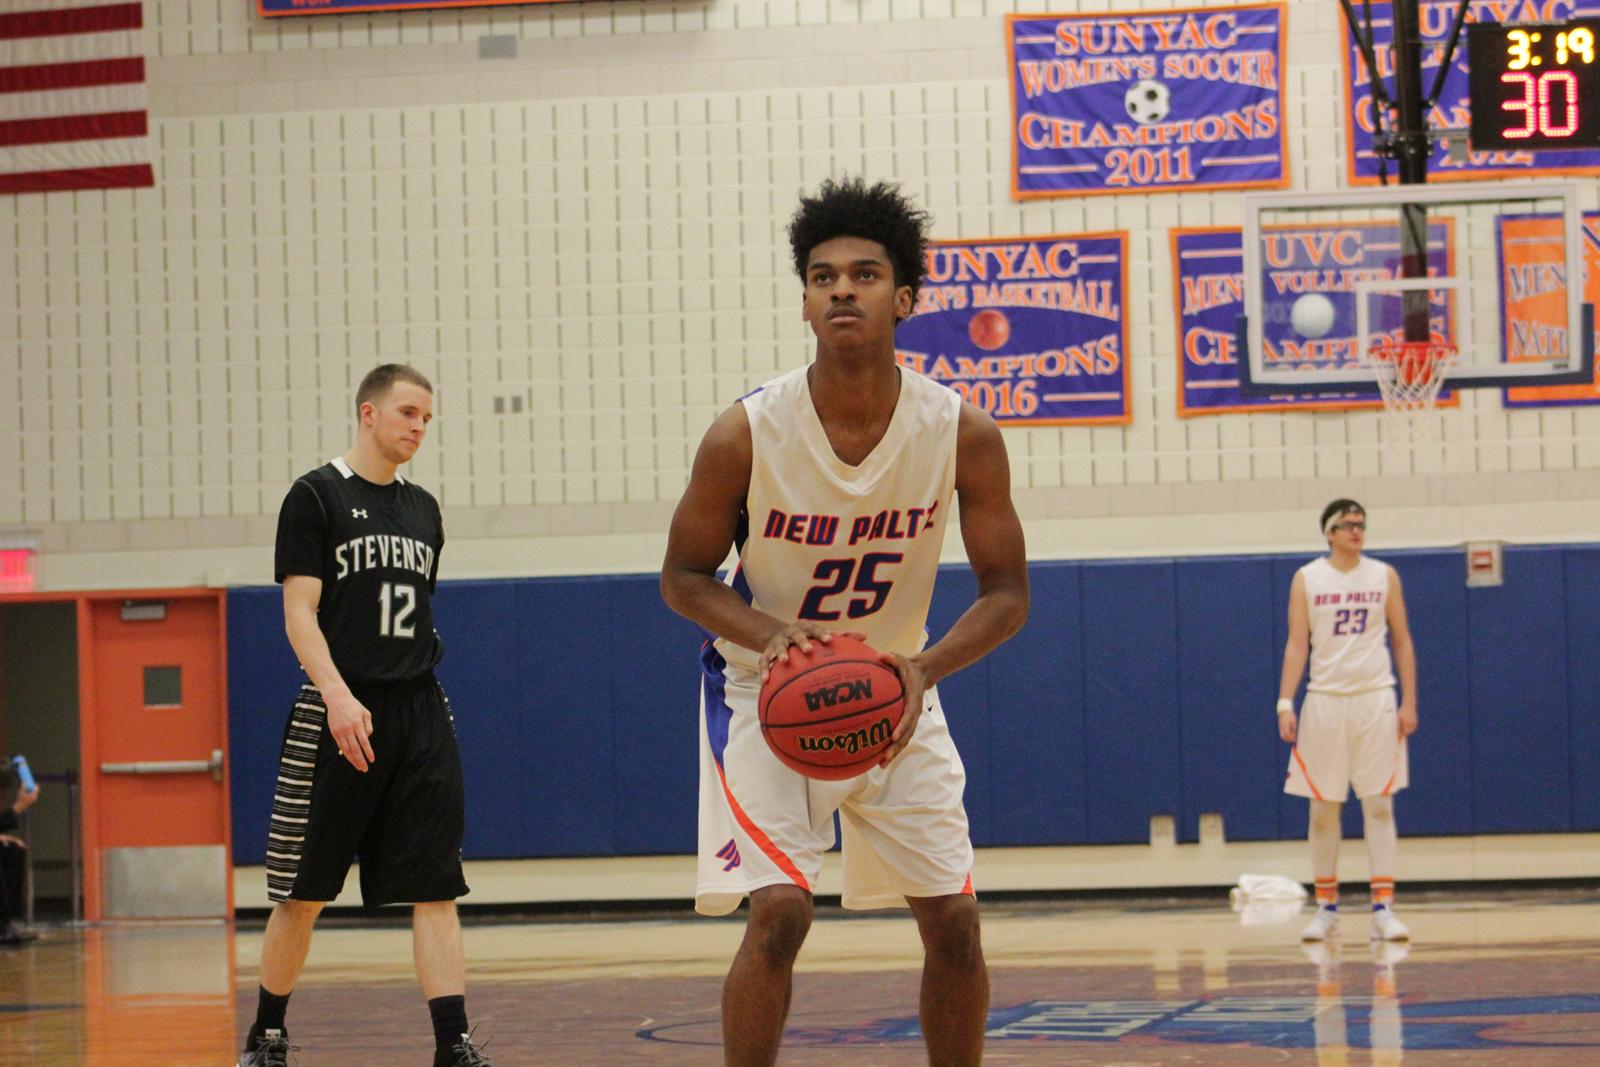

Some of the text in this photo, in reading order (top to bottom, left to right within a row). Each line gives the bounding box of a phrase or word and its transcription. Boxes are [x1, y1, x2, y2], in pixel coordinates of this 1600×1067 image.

[1055, 14, 1238, 55] SUNYAC
[1418, 0, 1576, 37] UNYAC
[1506, 27, 1595, 70] 3:19
[1018, 50, 1278, 99] WOMEN'S SOCCER
[1019, 99, 1278, 150] CHAMPIONS
[1501, 70, 1578, 138] 30
[1105, 146, 1195, 187] 2011
[923, 242, 1079, 283] UNYAC
[1262, 230, 1363, 269] UVC
[971, 277, 1119, 322] BASKETBALL
[895, 334, 1120, 380] HAMPIONS
[763, 508, 840, 546] NEW
[797, 552, 904, 621] 25
[1314, 592, 1382, 606] NEW PALTZ
[377, 581, 416, 638] 12
[1333, 608, 1368, 636] 23
[804, 678, 873, 712] NCAA
[799, 717, 894, 754] Wilson
